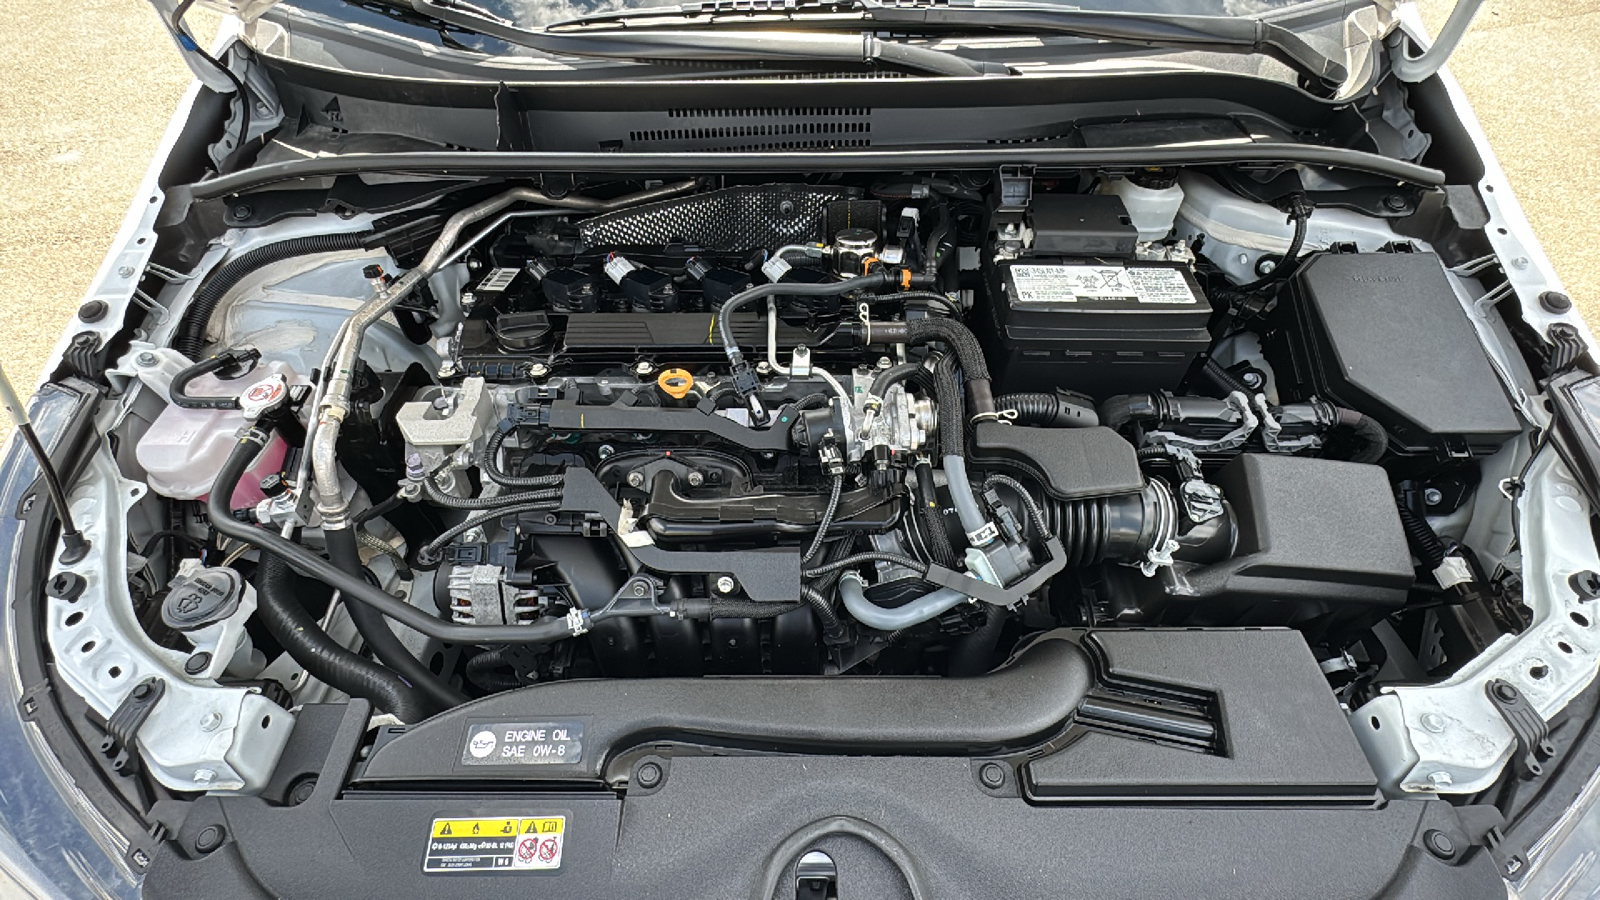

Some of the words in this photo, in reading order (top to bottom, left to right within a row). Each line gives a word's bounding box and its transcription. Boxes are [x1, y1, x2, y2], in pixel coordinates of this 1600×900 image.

[504, 730, 546, 742] ENGINE
[552, 729, 571, 741] OIL
[501, 745, 526, 757] SAE
[532, 744, 566, 757] 0W-8
